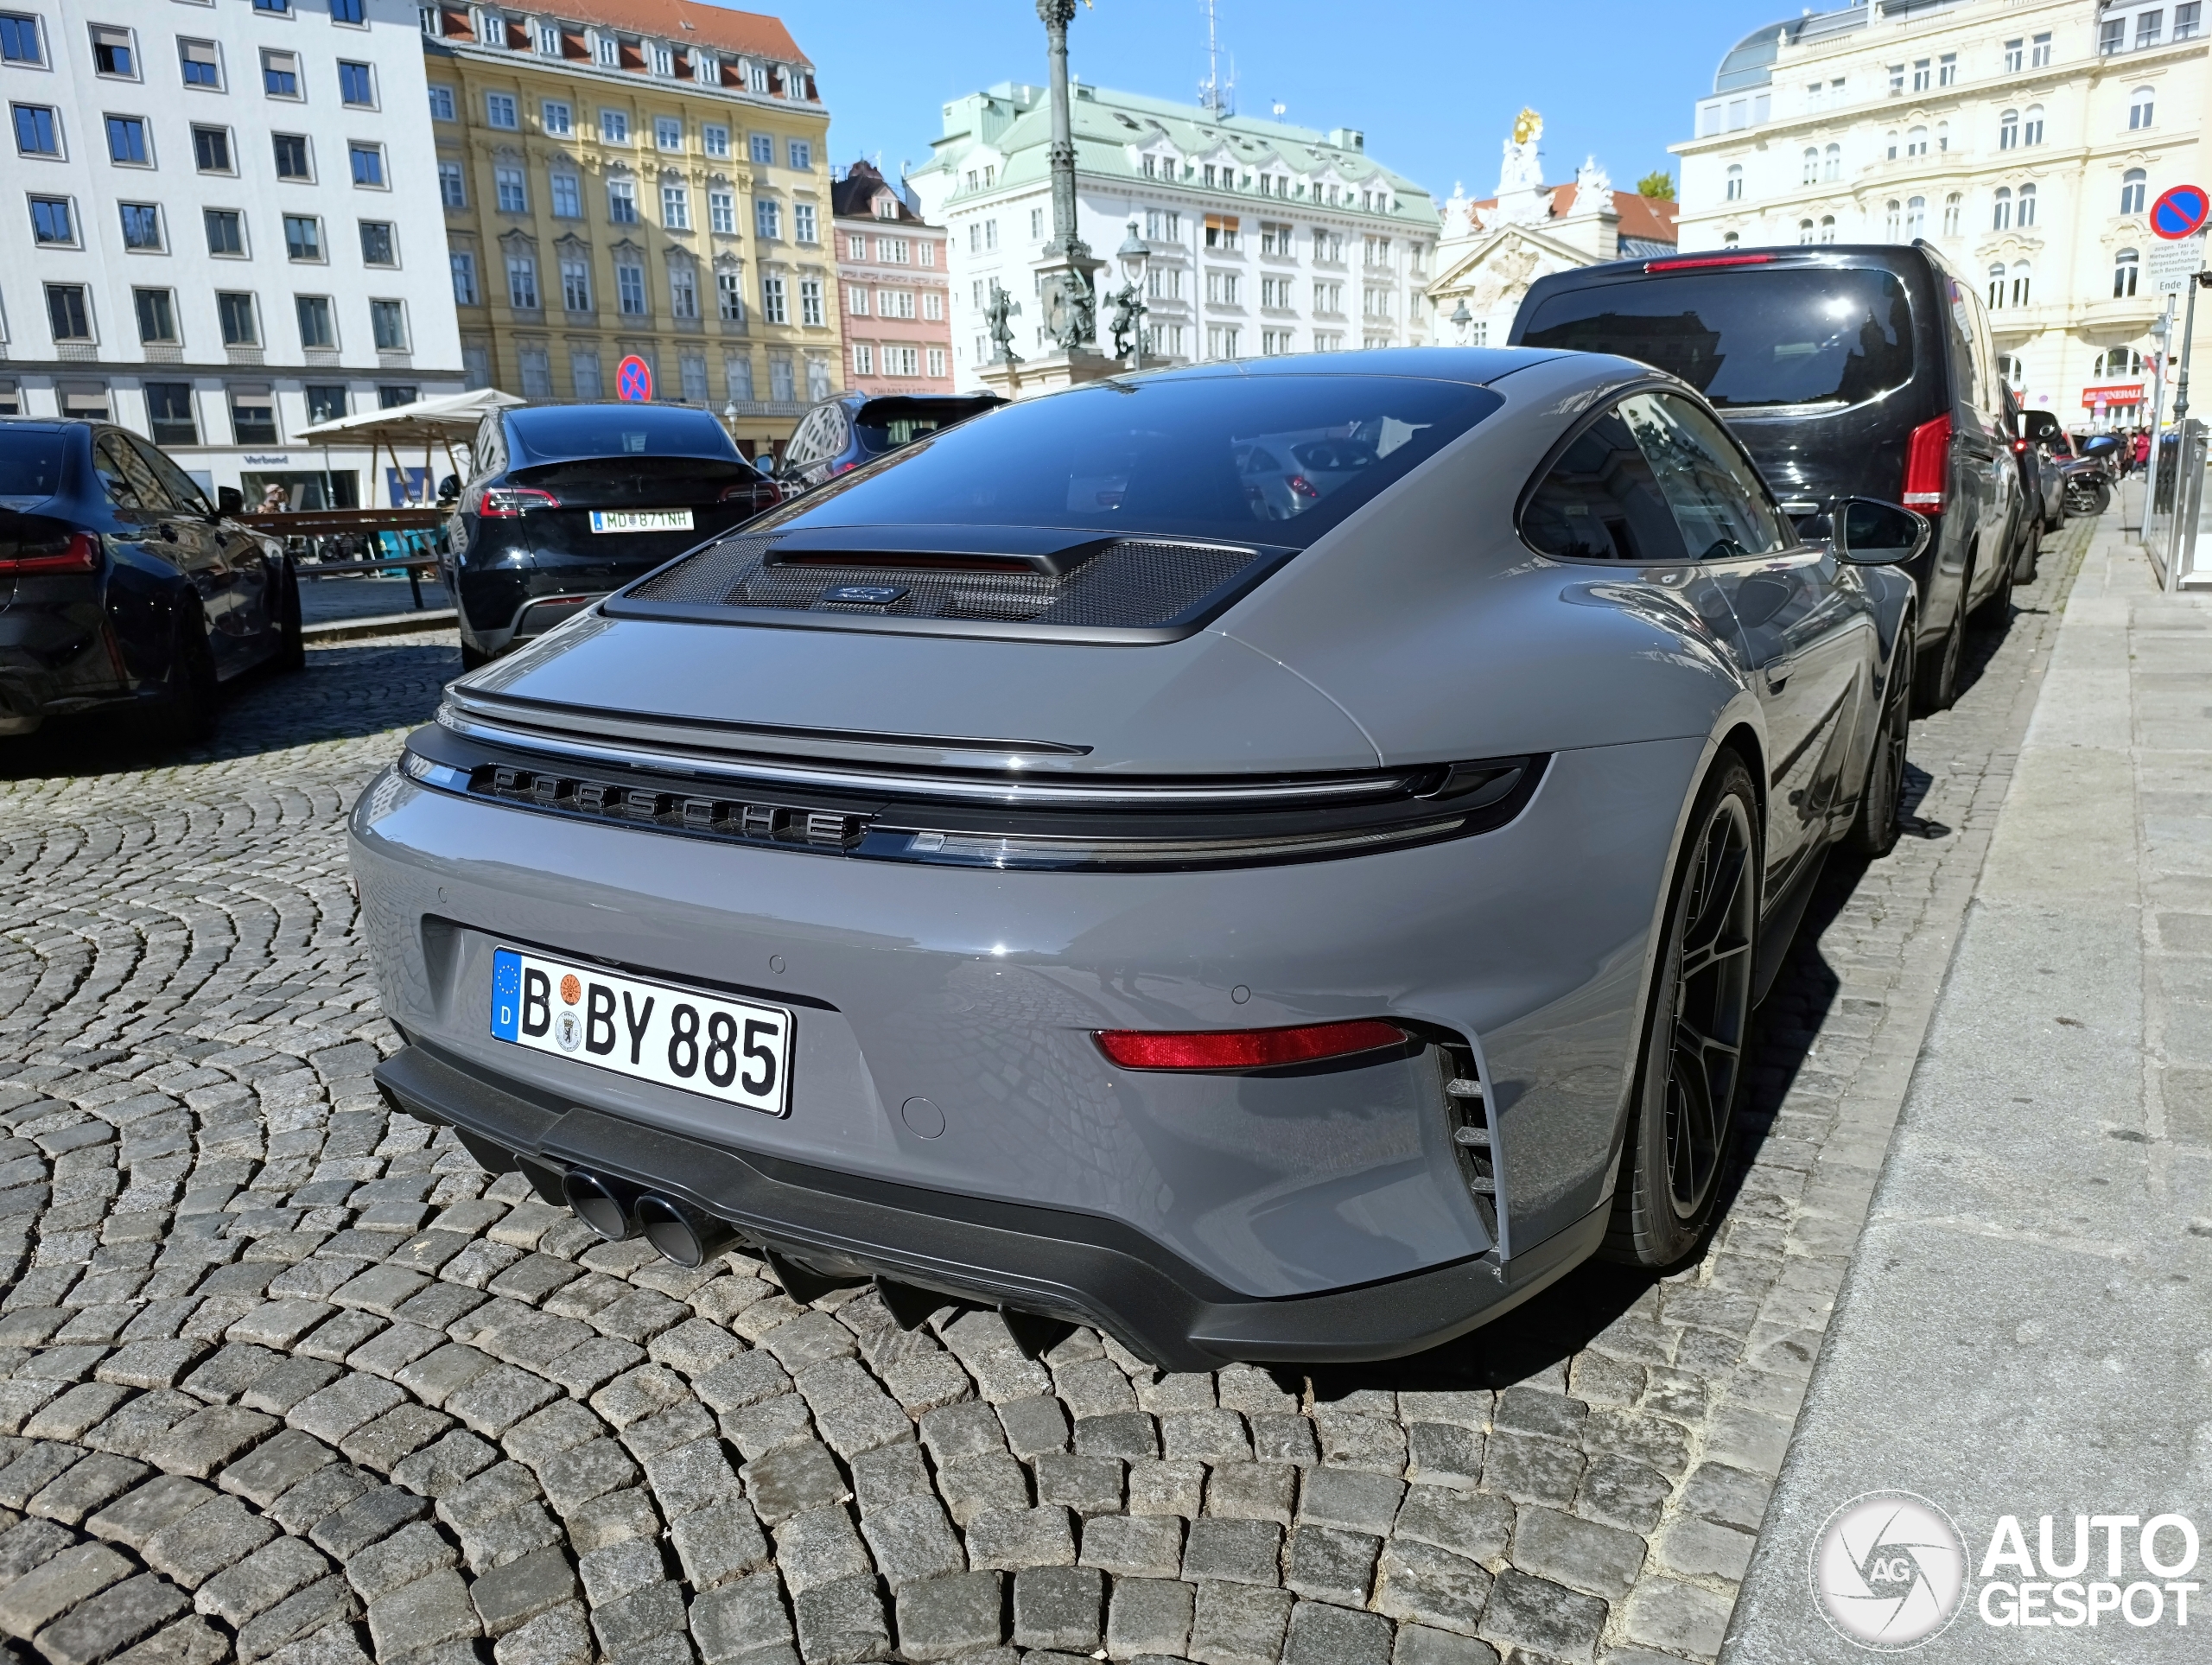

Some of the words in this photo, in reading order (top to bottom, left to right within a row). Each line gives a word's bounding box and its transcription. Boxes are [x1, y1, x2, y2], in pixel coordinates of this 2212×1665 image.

[2148, 257, 2199, 268] Fahrgastaufnahme
[2160, 280, 2182, 291] Ende
[243, 454, 289, 465] Verbund
[607, 512, 627, 528] MD
[639, 511, 688, 528] 871NH
[493, 766, 847, 841] PORSCHE
[500, 1006, 512, 1025] D
[522, 967, 551, 1038] B
[585, 982, 655, 1065] BY
[667, 1003, 779, 1097] 885
